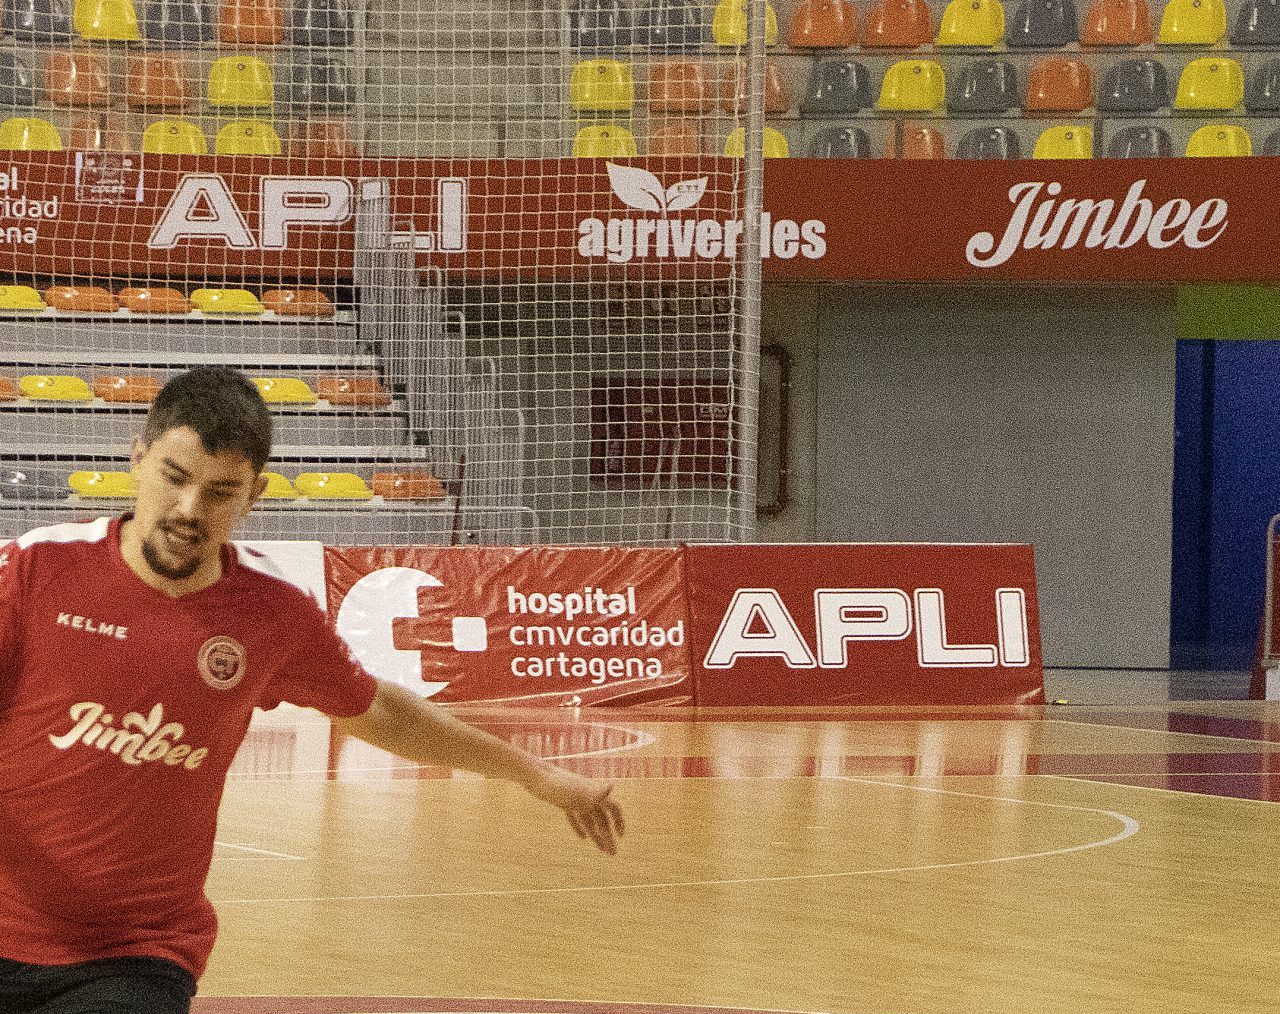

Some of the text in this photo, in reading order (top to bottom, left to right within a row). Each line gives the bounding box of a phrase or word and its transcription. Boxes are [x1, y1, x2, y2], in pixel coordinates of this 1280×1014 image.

[966, 179, 1229, 268] Jimbee
[507, 586, 636, 619] hospital
[57, 612, 128, 640] KELME
[509, 618, 686, 648] cmvcaridad
[703, 587, 1031, 670] APLI
[510, 652, 664, 684] cartagena
[49, 702, 209, 770] Jimbee
